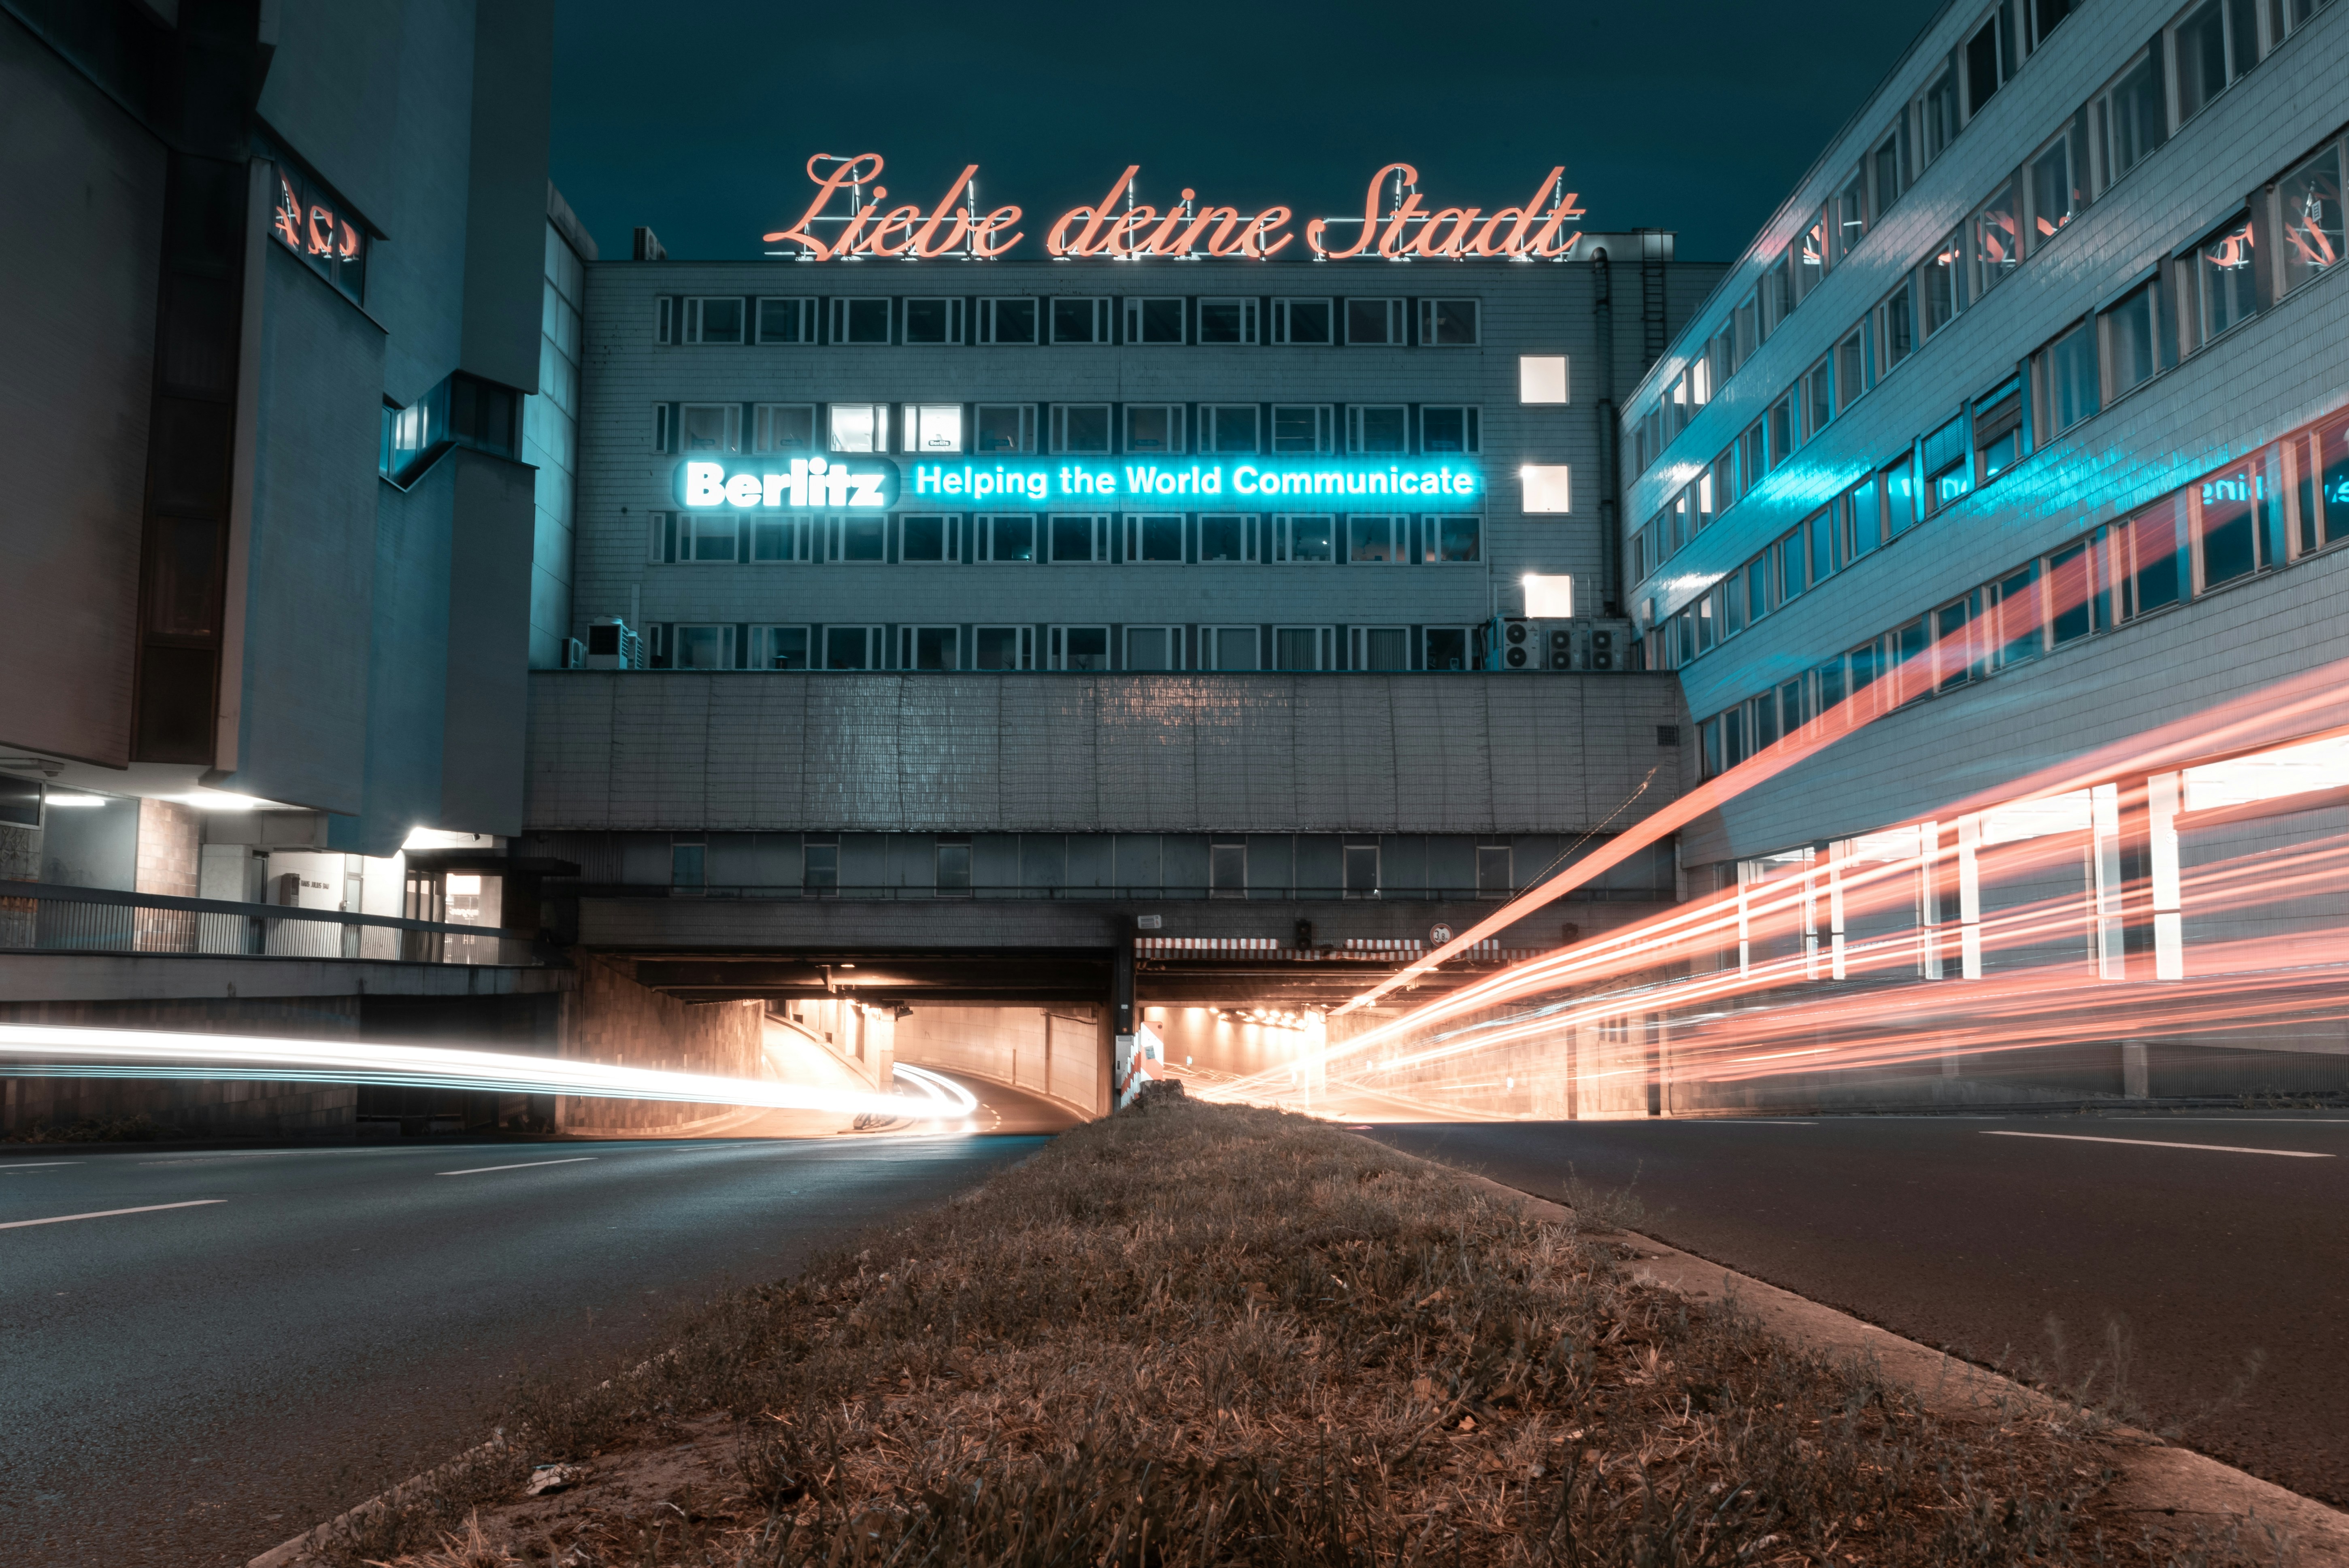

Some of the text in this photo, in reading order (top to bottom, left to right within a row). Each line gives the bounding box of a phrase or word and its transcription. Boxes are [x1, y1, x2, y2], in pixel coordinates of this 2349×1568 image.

[763, 154, 1586, 261] Liebe deine Stadt
[686, 457, 885, 507] Berlitz
[916, 465, 1475, 500] Helping the World Communicate
